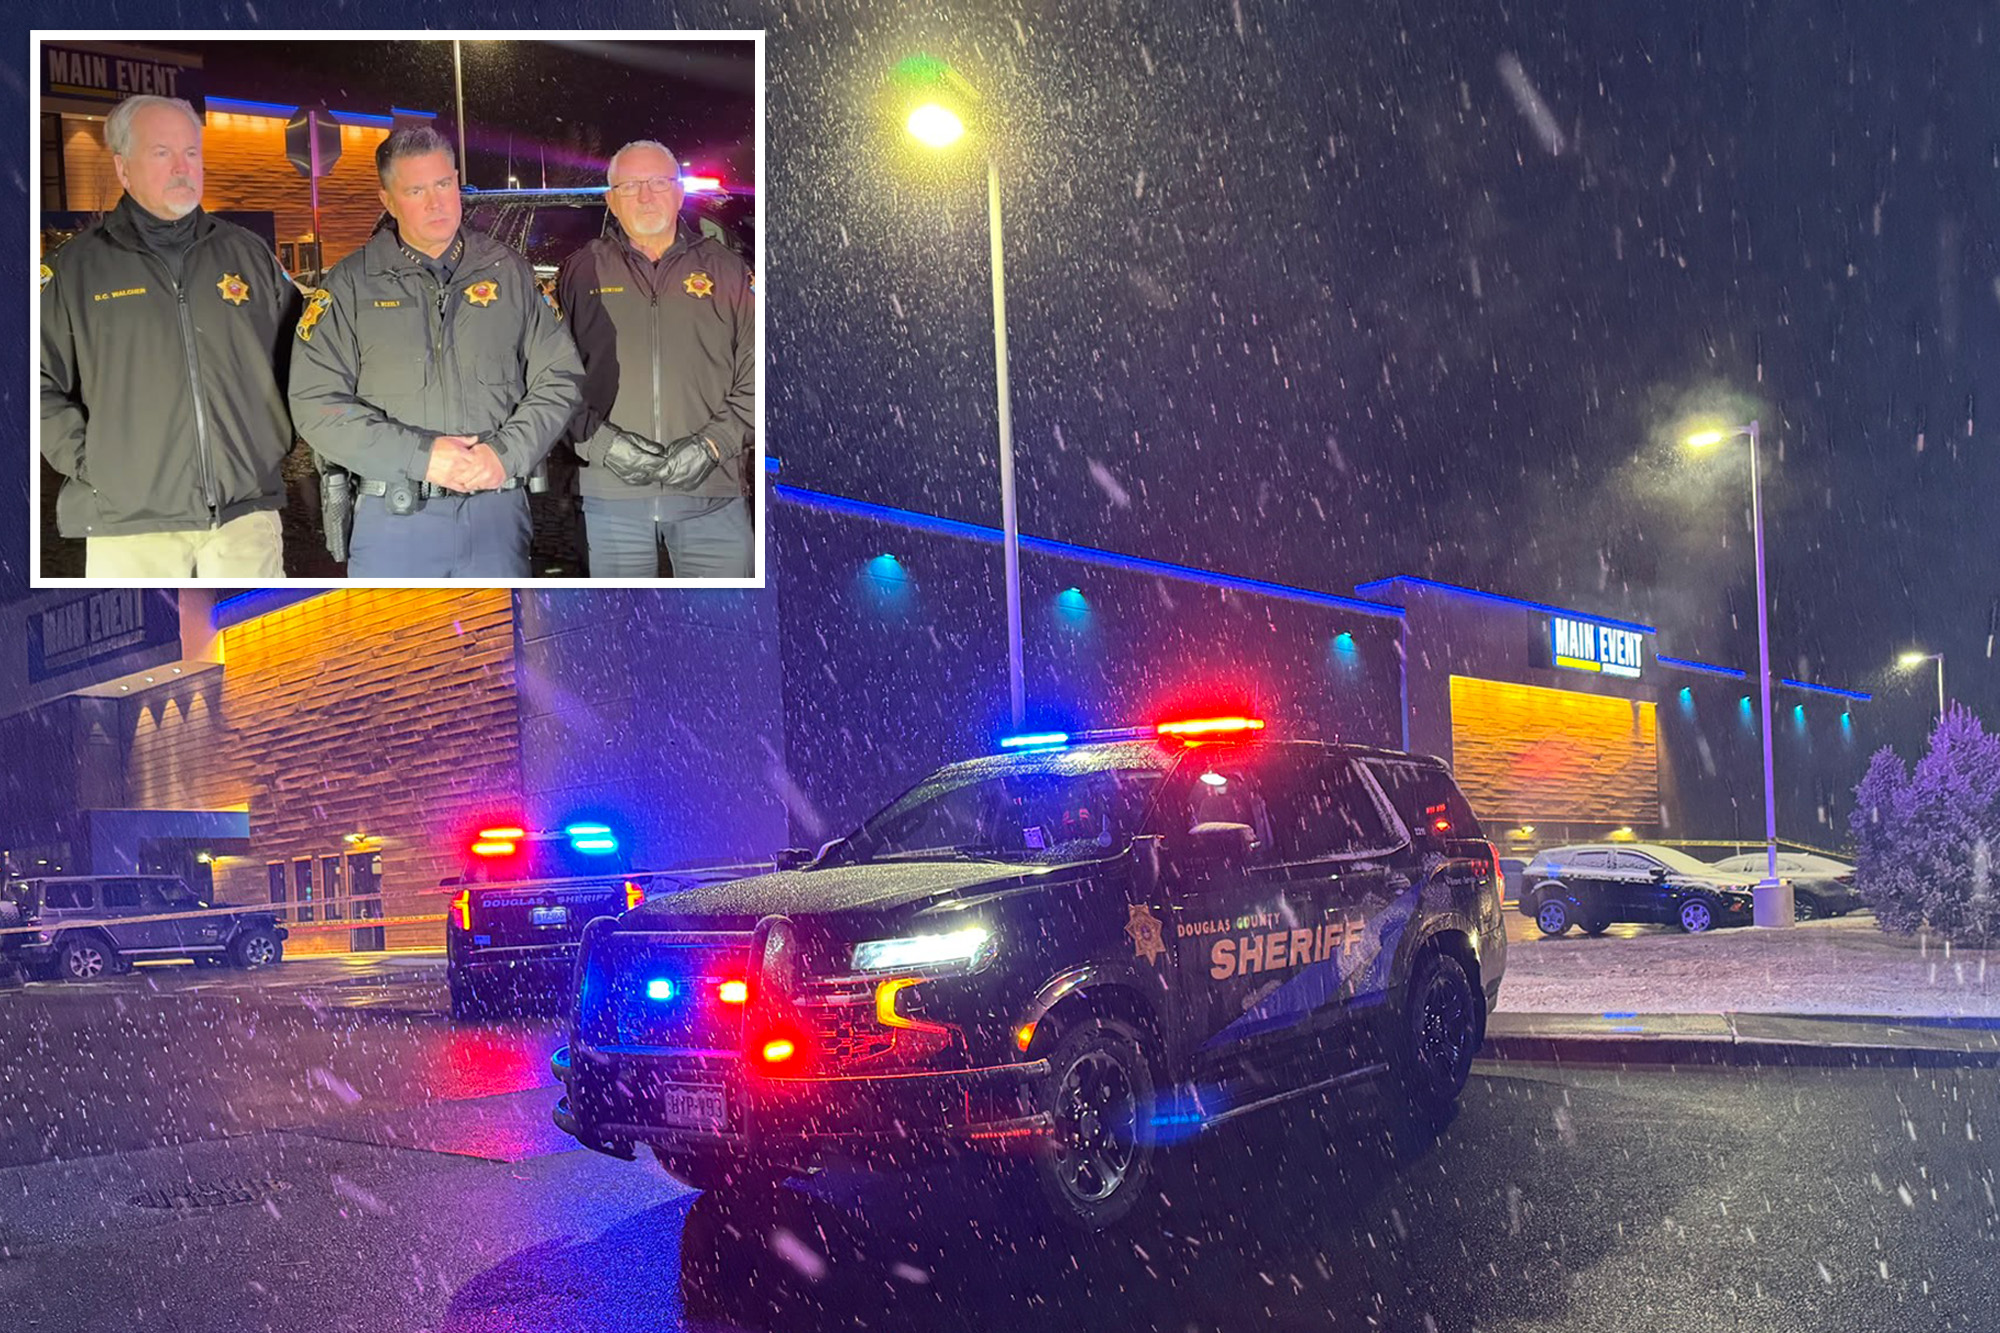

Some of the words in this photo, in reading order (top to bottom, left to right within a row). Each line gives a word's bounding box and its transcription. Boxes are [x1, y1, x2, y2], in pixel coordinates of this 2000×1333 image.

[49, 50, 108, 88] MAIN
[116, 60, 178, 97] EVENT
[1555, 617, 1595, 660] MAIN
[1599, 626, 1643, 668] EVENT
[483, 897, 545, 908] DOUGLAS
[557, 894, 613, 904] SHERIFF
[1177, 921, 1231, 938] DOUGLAS
[1236, 912, 1281, 931] COUNTY
[1210, 919, 1366, 981] SHERIFF
